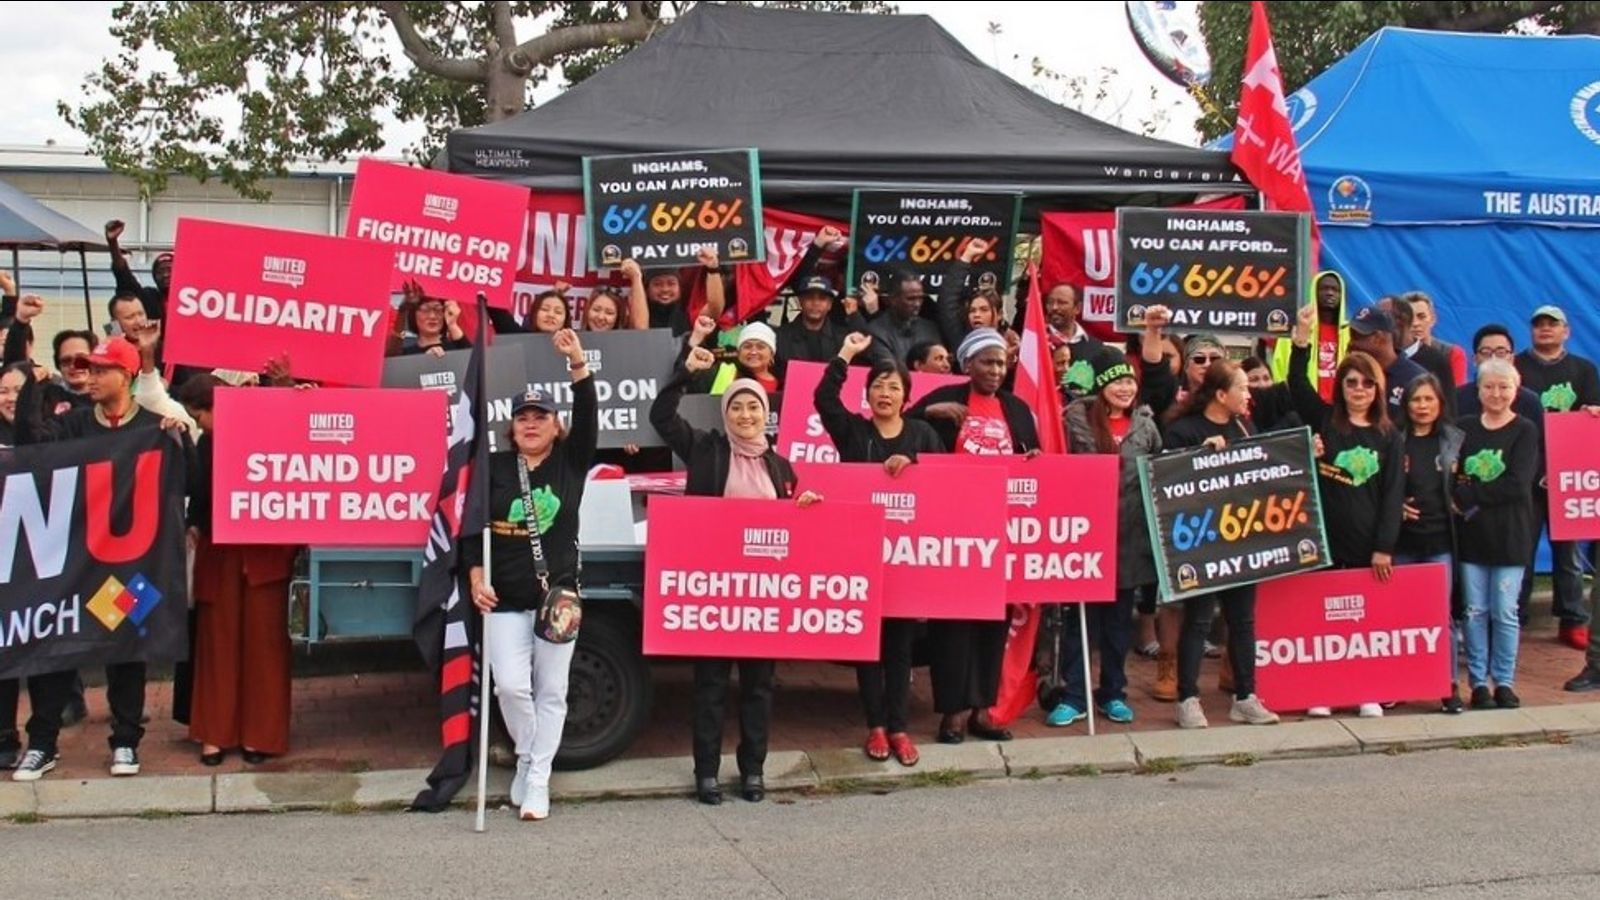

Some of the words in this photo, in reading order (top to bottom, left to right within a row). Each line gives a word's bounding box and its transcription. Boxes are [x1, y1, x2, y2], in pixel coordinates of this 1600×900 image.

[475, 149, 523, 159] ULTIMATE
[632, 161, 708, 174] INGHAMS,
[600, 182, 632, 194] YOU
[635, 179, 666, 192] CAN
[671, 177, 742, 190] AFFORD...
[425, 193, 459, 211] UNITED
[900, 198, 973, 211] INGHAMS,
[1484, 191, 1522, 214] THE
[602, 204, 648, 235] 6%
[652, 201, 696, 233] 6%
[698, 199, 743, 230] 6%
[867, 214, 897, 225] YOU
[901, 215, 931, 226] CAN
[934, 216, 1002, 226] AFFORD...
[1166, 218, 1250, 234] INGHAMS,
[357, 217, 462, 253] FIGHTING
[465, 236, 511, 262] FOR
[863, 234, 908, 263] 6%
[910, 234, 956, 263] 6%
[1129, 237, 1165, 249] YOU
[1169, 238, 1204, 251] CAN
[1208, 240, 1288, 253] AFFORD...
[631, 245, 670, 259] PAY
[264, 255, 306, 274] UNITED
[395, 251, 444, 277] URE
[446, 261, 503, 287] JOBS
[1129, 262, 1180, 295] 6%
[1183, 264, 1234, 297] 6%
[1235, 265, 1286, 298] 6%
[177, 287, 382, 337] SOLIDARITY
[1208, 310, 1257, 326] UP!!!
[420, 371, 456, 387] UNITED
[618, 379, 657, 401] ON
[309, 413, 354, 429] UNITED
[246, 453, 359, 483] STAND
[367, 454, 417, 483] UP
[1193, 447, 1268, 470] INGHAMS,
[1163, 482, 1195, 499] YOU
[1199, 475, 1230, 492] CAN
[1234, 465, 1303, 486] AFFORD...
[230, 491, 330, 520] FIGHT
[340, 491, 432, 520] BACK
[872, 492, 915, 508] UNITED
[1564, 497, 1600, 519] SE
[744, 528, 789, 545] UNITED
[1049, 516, 1090, 543] UP
[1024, 552, 1103, 579] BACK
[1205, 555, 1243, 580] PAY
[1249, 546, 1290, 570] UP!!!
[660, 570, 801, 599] FIGHTING
[809, 574, 869, 601] FOR
[1324, 595, 1364, 610] UNITED
[663, 604, 780, 633] SECURE
[787, 608, 864, 635] JOBS
[1254, 626, 1442, 667] SOLIDARITY
